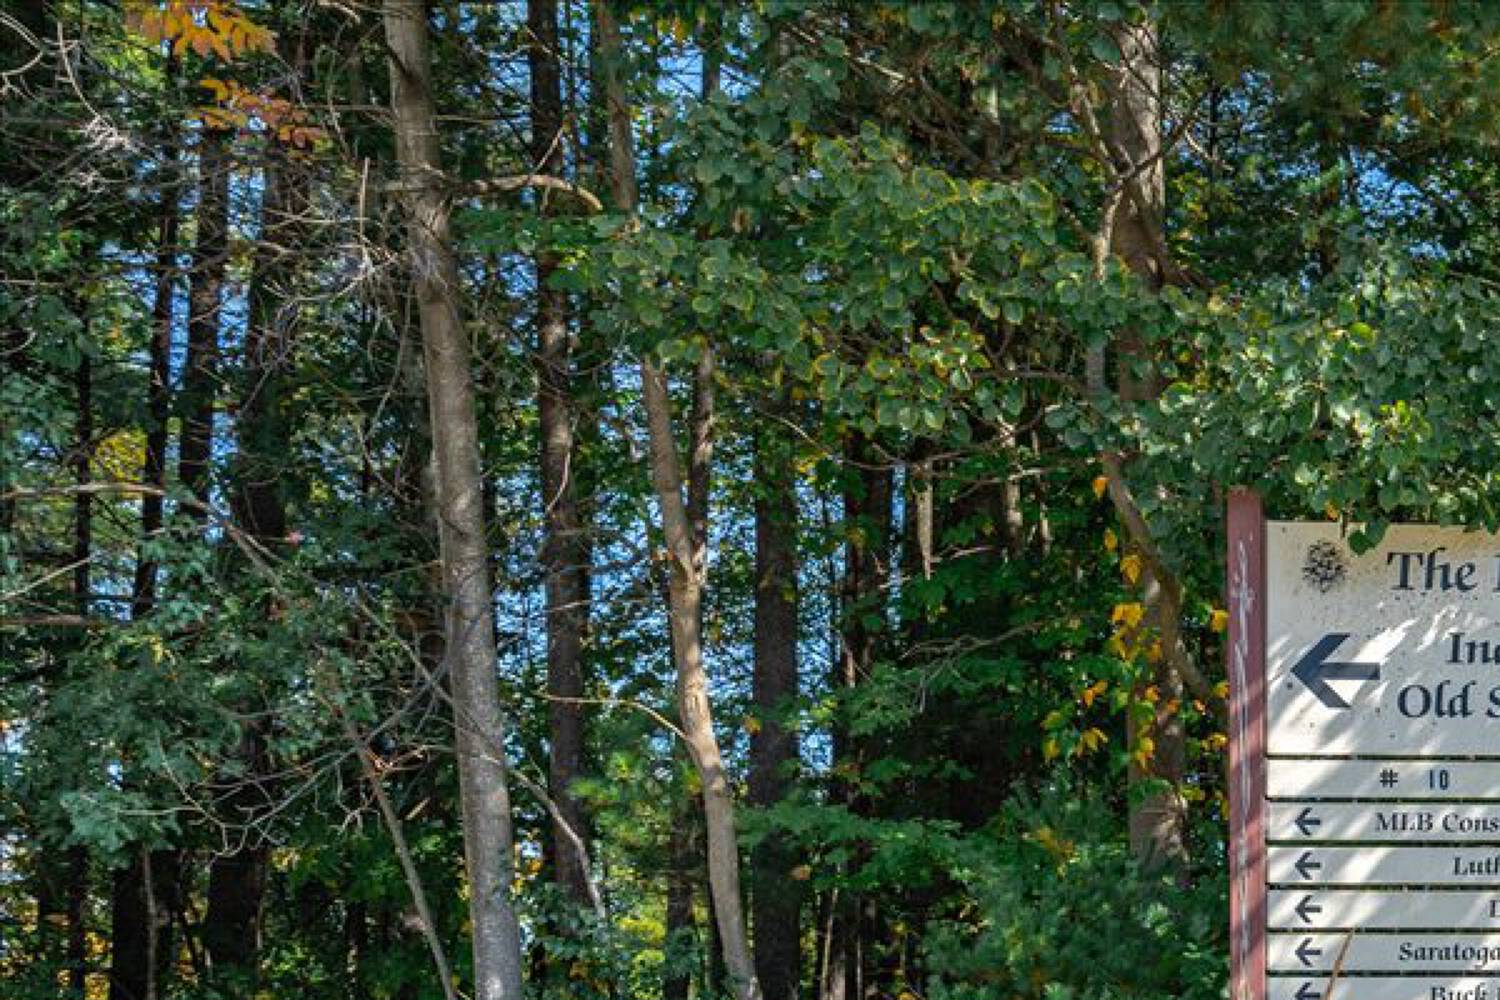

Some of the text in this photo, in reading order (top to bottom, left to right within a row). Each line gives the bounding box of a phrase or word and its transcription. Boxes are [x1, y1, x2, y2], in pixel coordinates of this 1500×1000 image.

[1387, 548, 1477, 594] The
[1397, 682, 1479, 718] Old
[1379, 769, 1399, 788] #
[1428, 769, 1449, 790] 10
[1375, 813, 1434, 832] MLB
